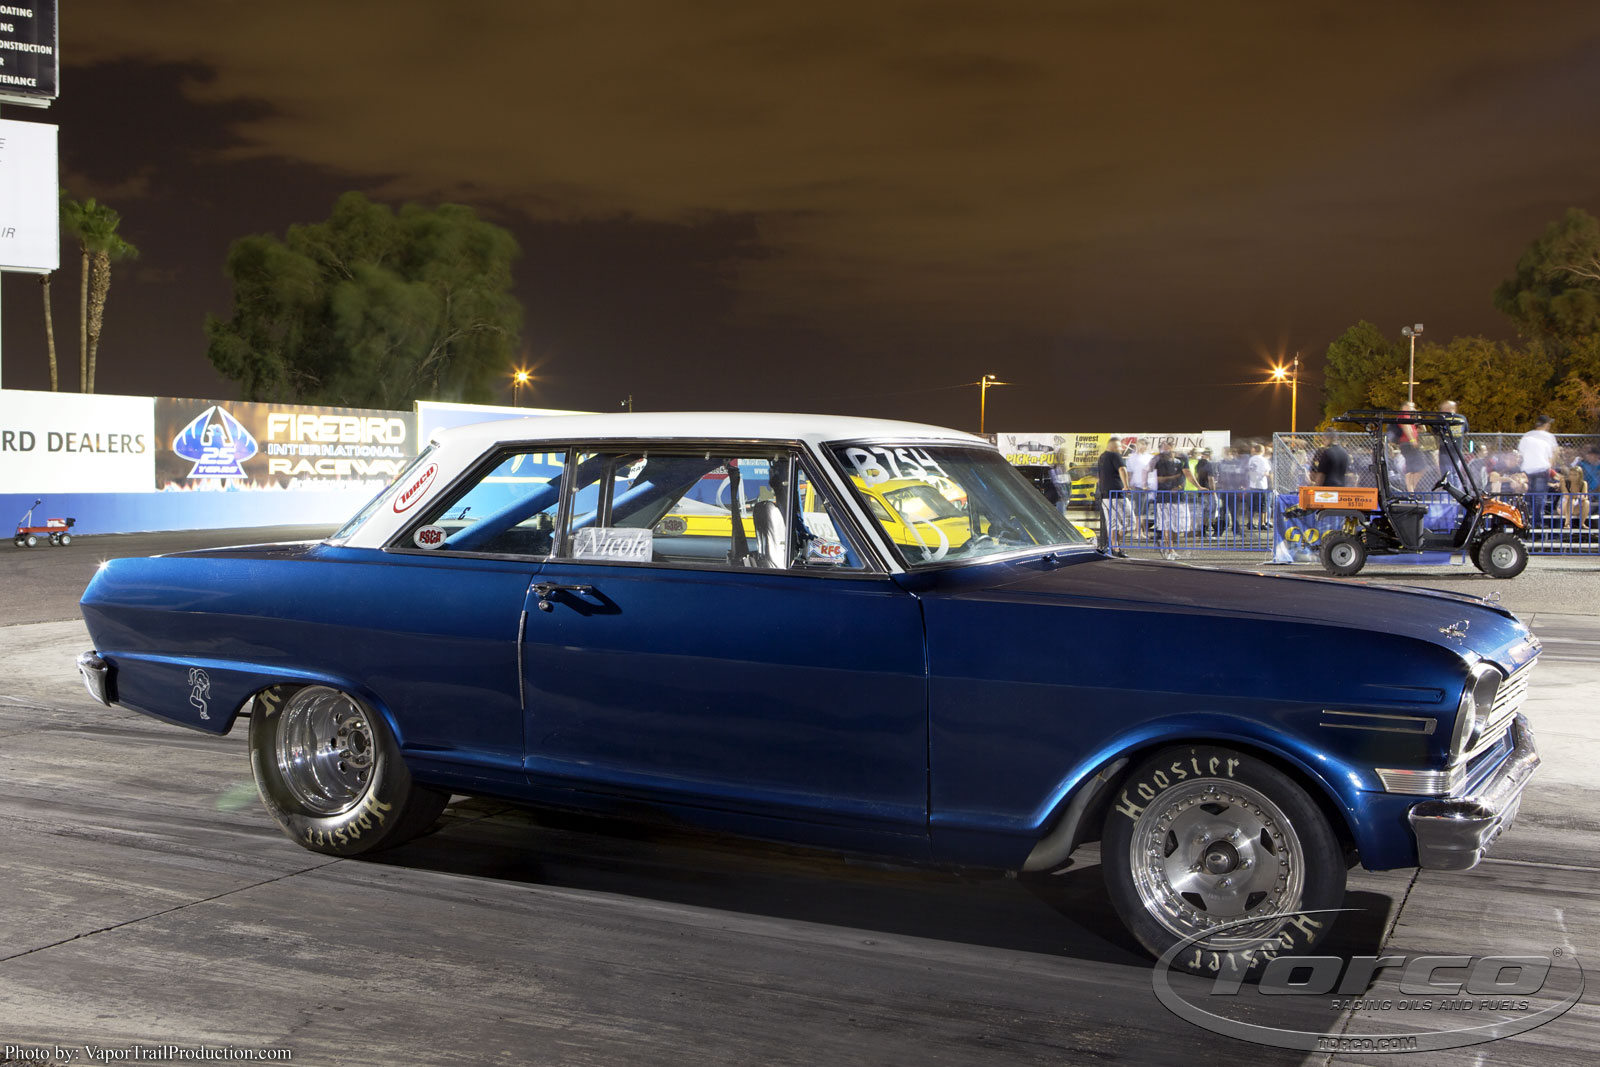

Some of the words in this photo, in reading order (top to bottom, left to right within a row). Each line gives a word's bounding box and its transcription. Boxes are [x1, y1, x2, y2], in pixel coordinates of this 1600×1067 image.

[267, 412, 407, 444] FIREBIRD
[47, 431, 146, 454] DEALERS
[267, 443, 404, 458] INTERNATIONAL
[200, 447, 237, 465] 25
[268, 458, 407, 476] RACEWAY
[576, 528, 650, 557] Nicole
[820, 545, 841, 556] RFC
[1116, 749, 1240, 826] Hoosier
[306, 788, 392, 850] Hoosier
